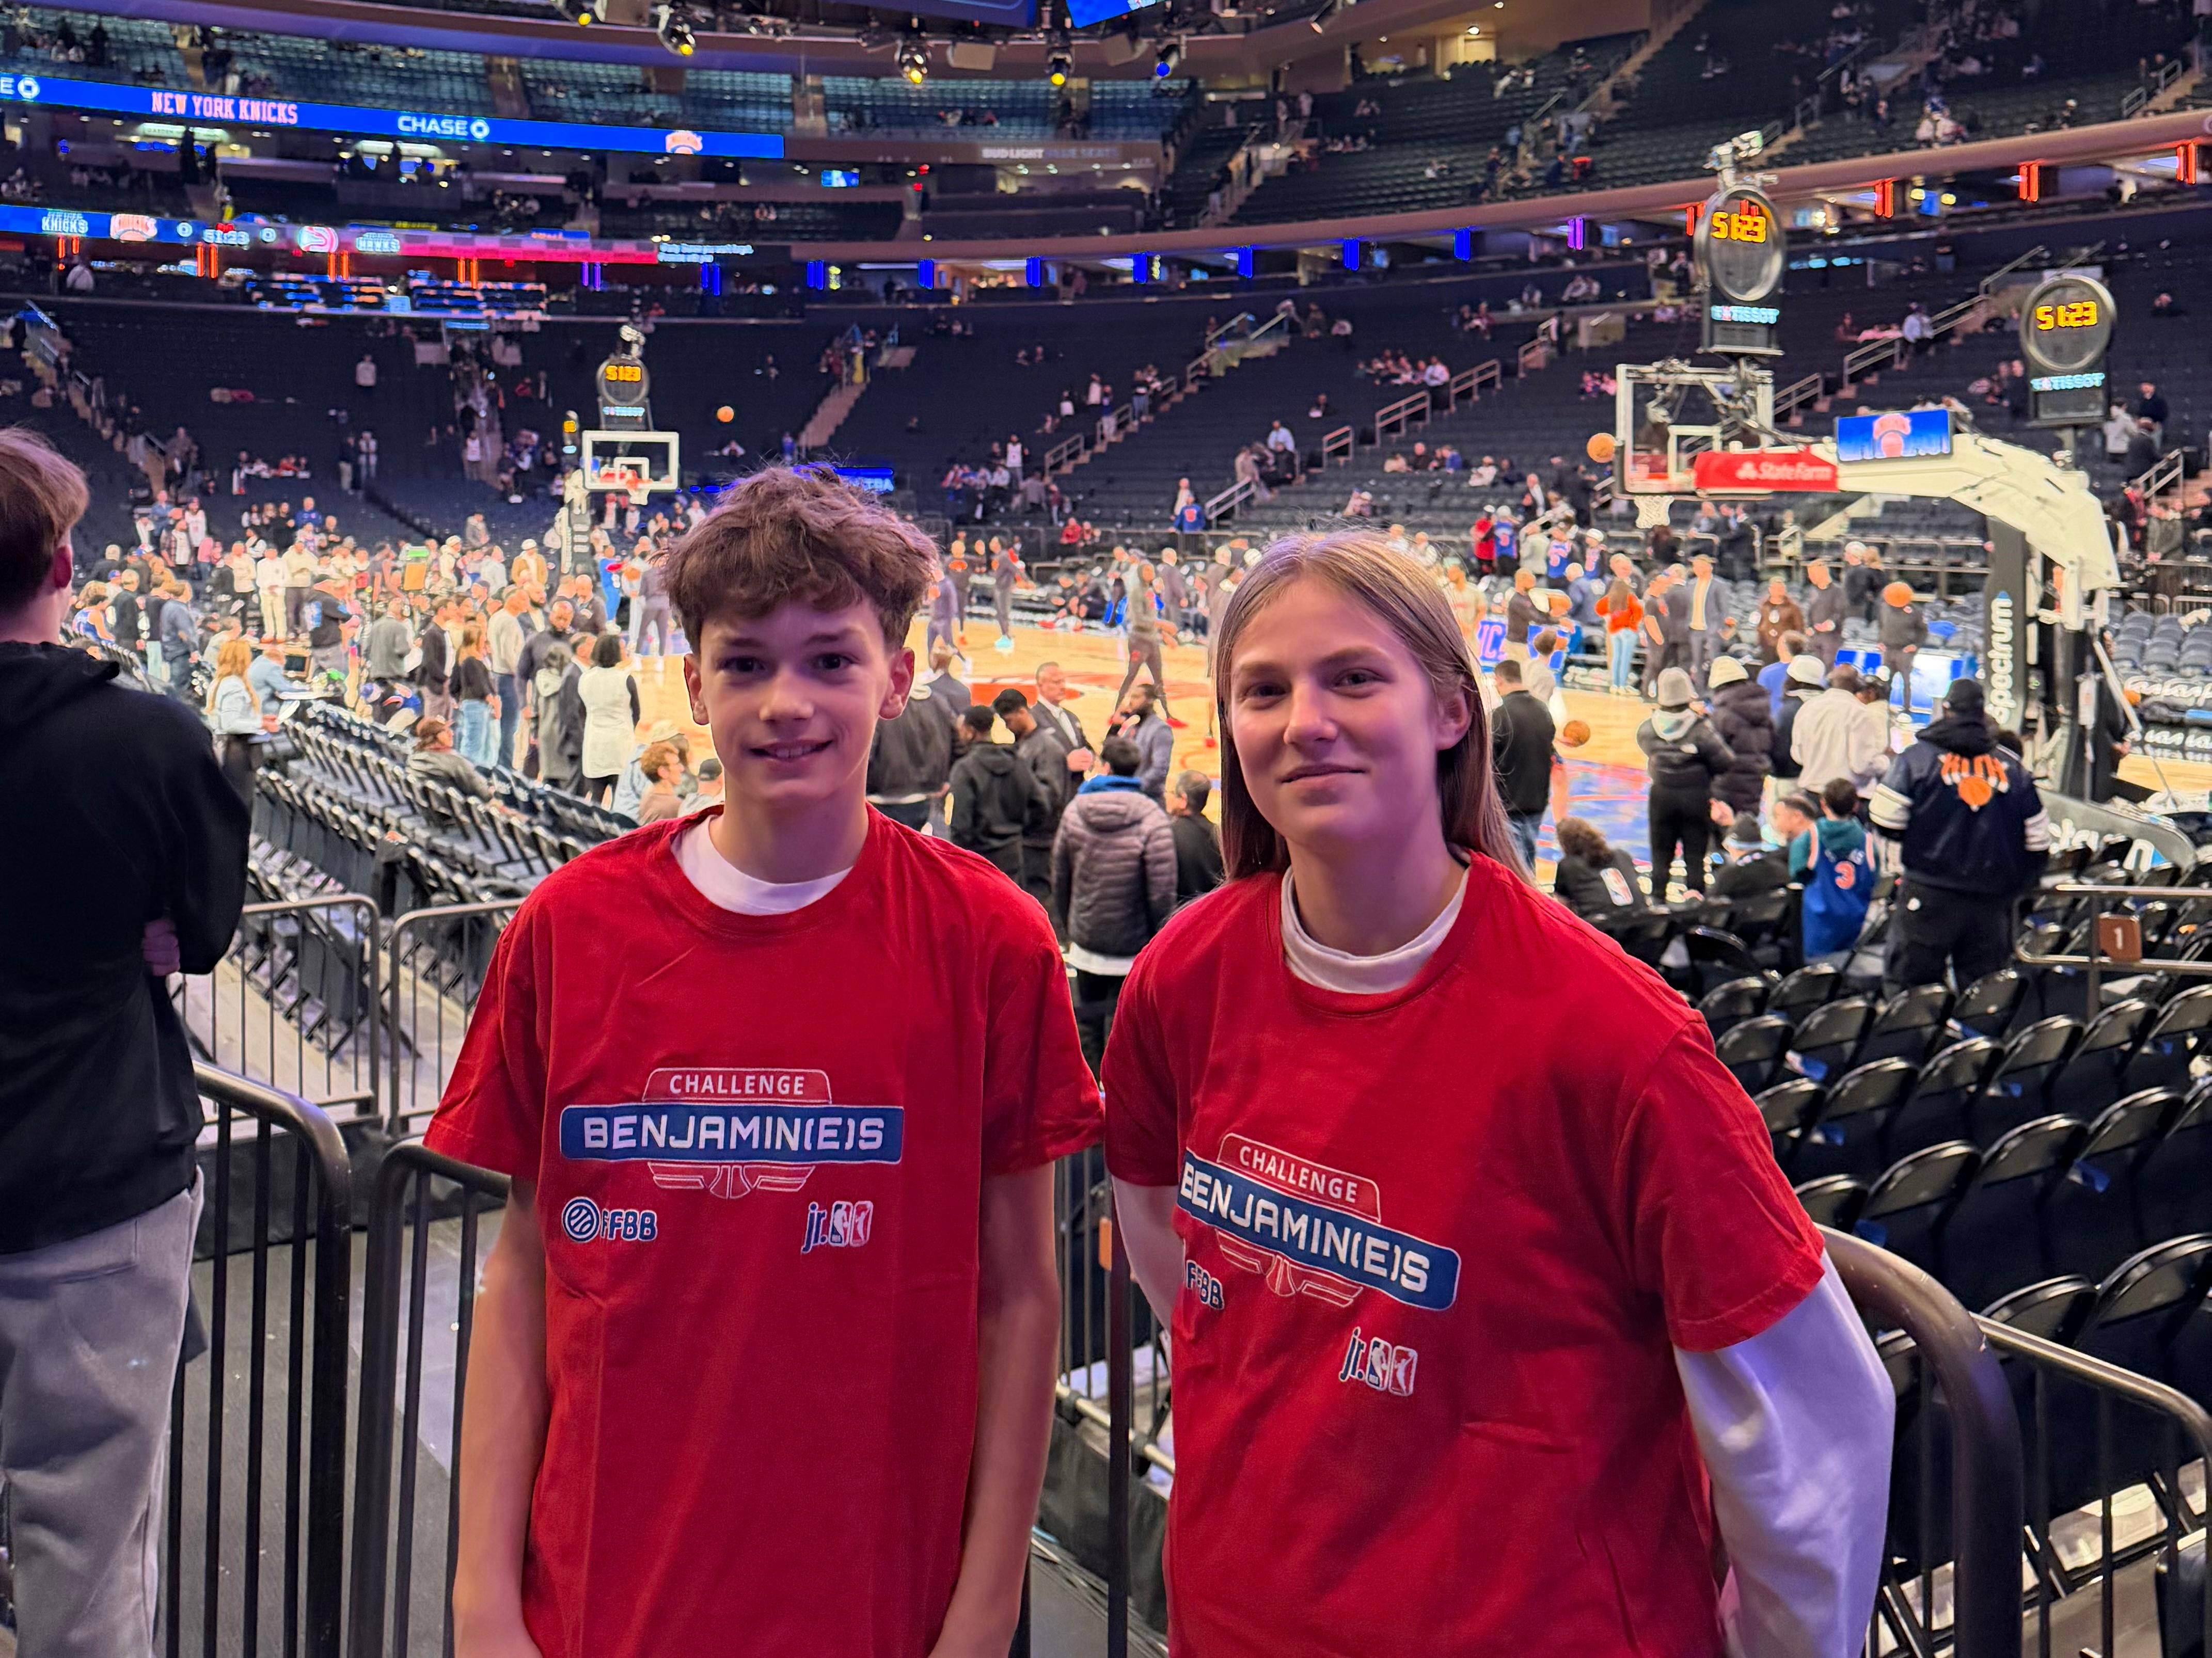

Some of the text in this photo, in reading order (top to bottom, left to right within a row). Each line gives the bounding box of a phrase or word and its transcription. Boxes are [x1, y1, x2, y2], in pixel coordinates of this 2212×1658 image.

[152, 91, 298, 124] NEW YORK KNICKS
[398, 115, 468, 136] CHASE
[42, 216, 88, 234] KNICKS
[1758, 461, 1832, 481] State Farm
[1835, 860, 1855, 890] 3
[2114, 926, 2123, 950] 1
[670, 1074, 804, 1095] CHALLENGE
[583, 1114, 884, 1151] BENJAMIN(E)S
[1239, 1146, 1357, 1203] CHALLENGE
[601, 1208, 658, 1241] FFBB
[1180, 1161, 1430, 1293] BENJAMIN(E)S
